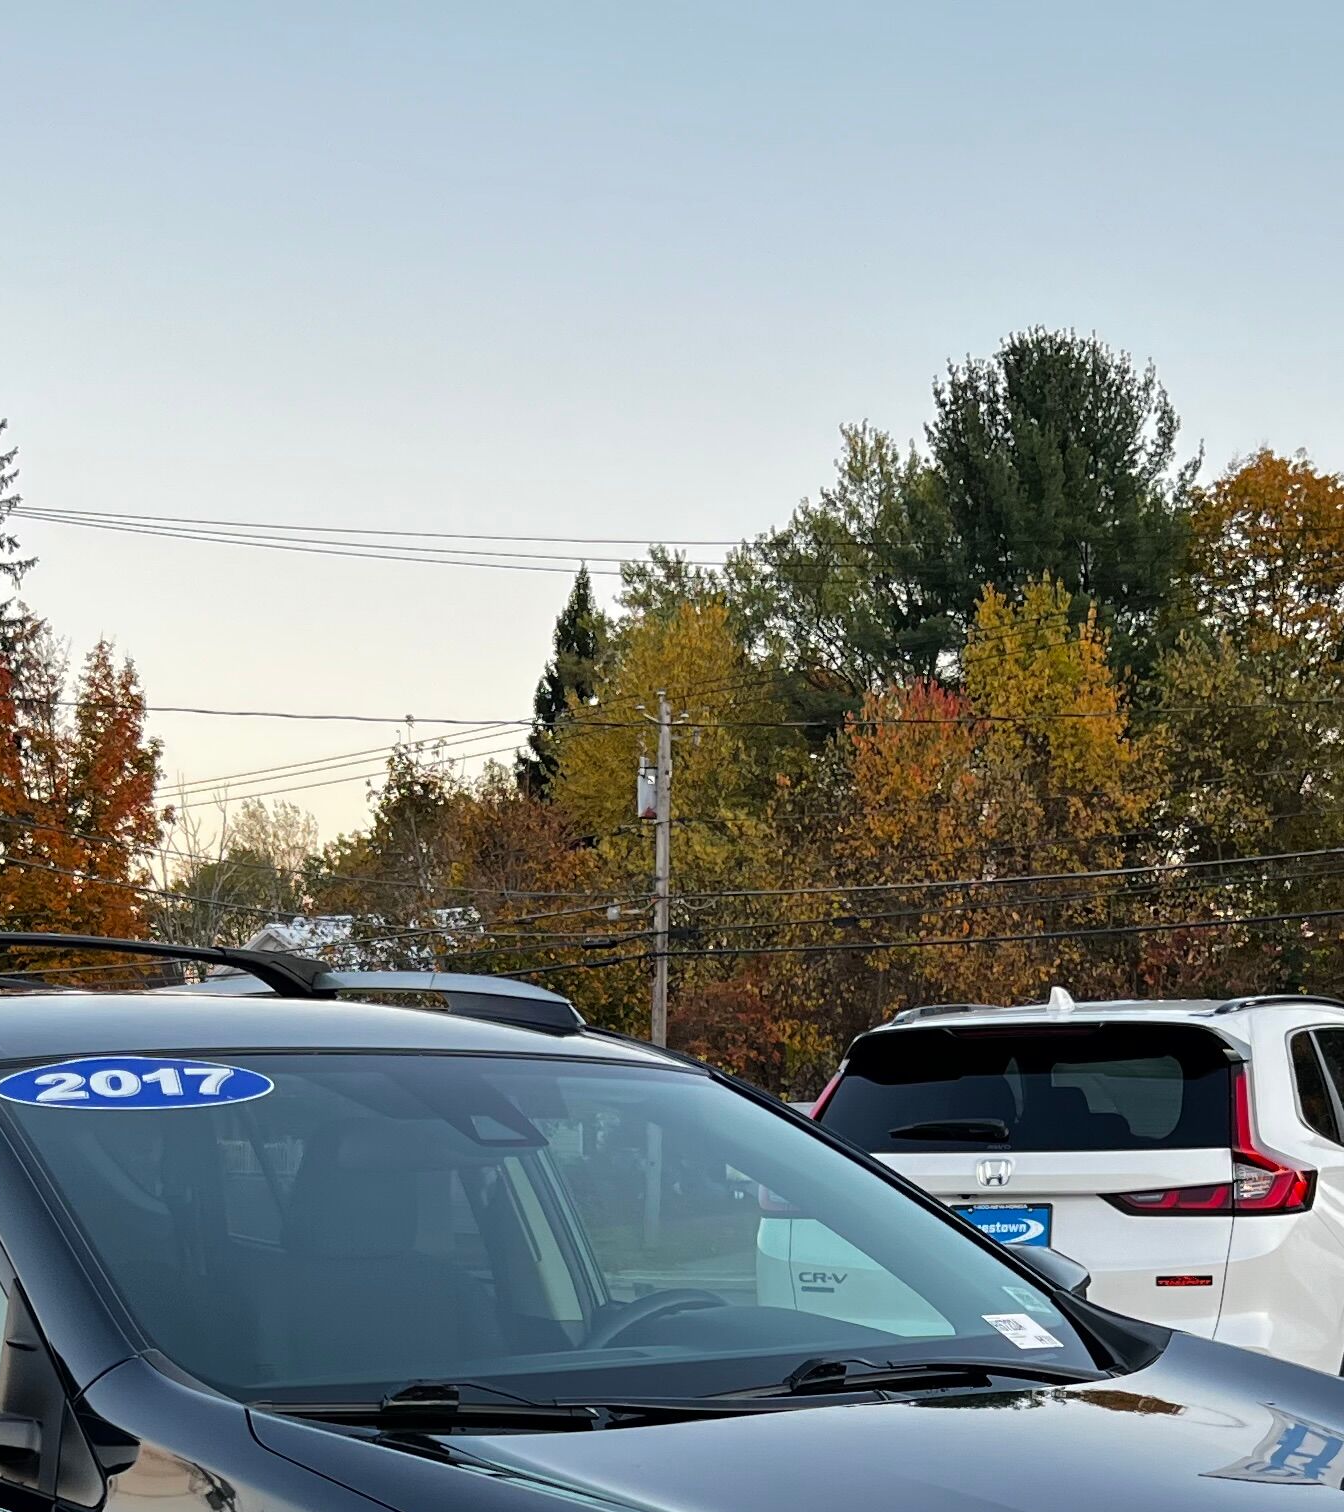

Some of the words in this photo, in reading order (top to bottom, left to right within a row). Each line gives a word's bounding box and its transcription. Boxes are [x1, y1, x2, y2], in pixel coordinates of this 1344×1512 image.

[34, 1067, 235, 1102] 2017
[977, 1221, 1027, 1233] estown
[798, 1271, 848, 1284] CR-V
